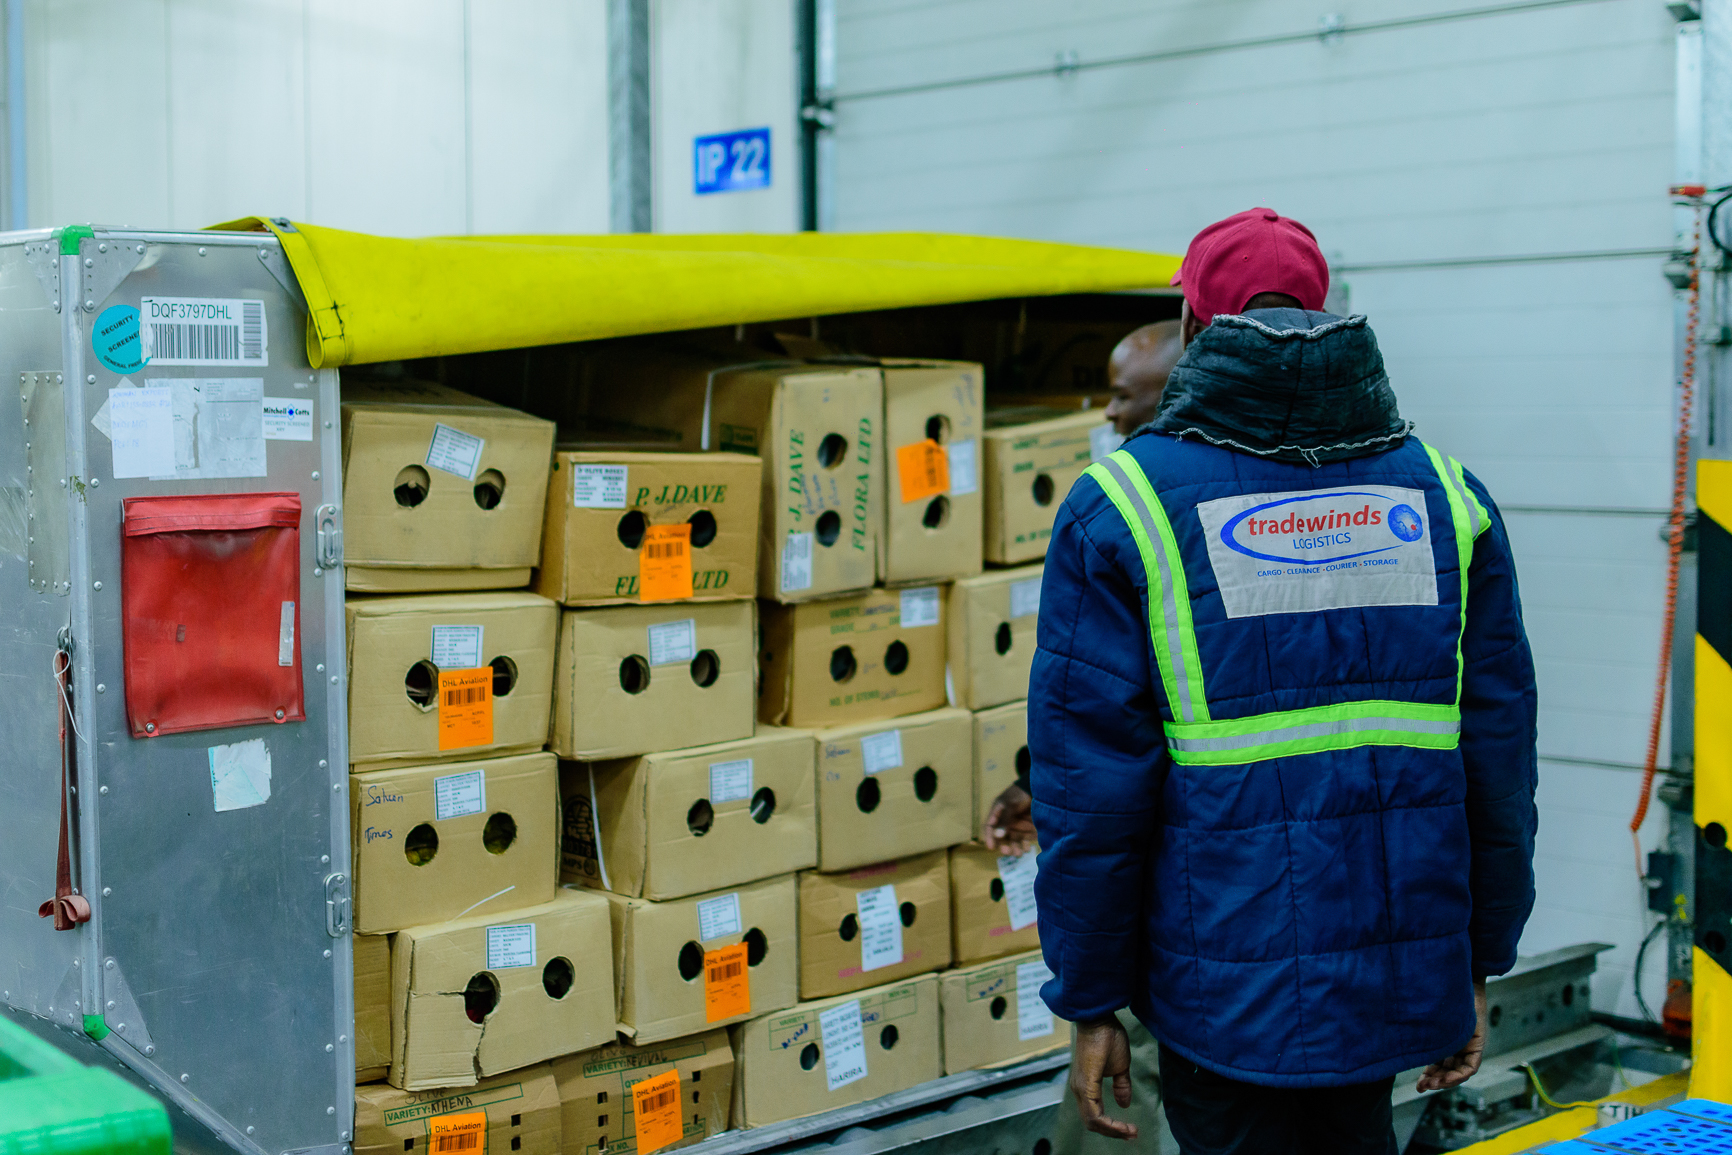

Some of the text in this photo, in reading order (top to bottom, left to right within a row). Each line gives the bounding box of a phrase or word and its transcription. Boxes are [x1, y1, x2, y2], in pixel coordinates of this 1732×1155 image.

[698, 137, 765, 185] IP 22
[151, 303, 232, 320] DQF3797DHL
[100, 313, 134, 336] SECURITY
[107, 330, 140, 353] SCREENE
[788, 428, 805, 494] DAVE
[852, 417, 872, 552] FLORA LTD
[1248, 504, 1382, 536] tradewinds
[1292, 532, 1352, 550] LOGISTICS
[1257, 558, 1398, 577] CARGO CLEAANCE COURIER STORAGE
[615, 576, 640, 596] FL
[459, 676, 488, 685] Aviation
[636, 1080, 677, 1098] DHL Aviation
[387, 1096, 473, 1122] VARIETY: ATHENA
[435, 1122, 482, 1134] DHL Aviation
